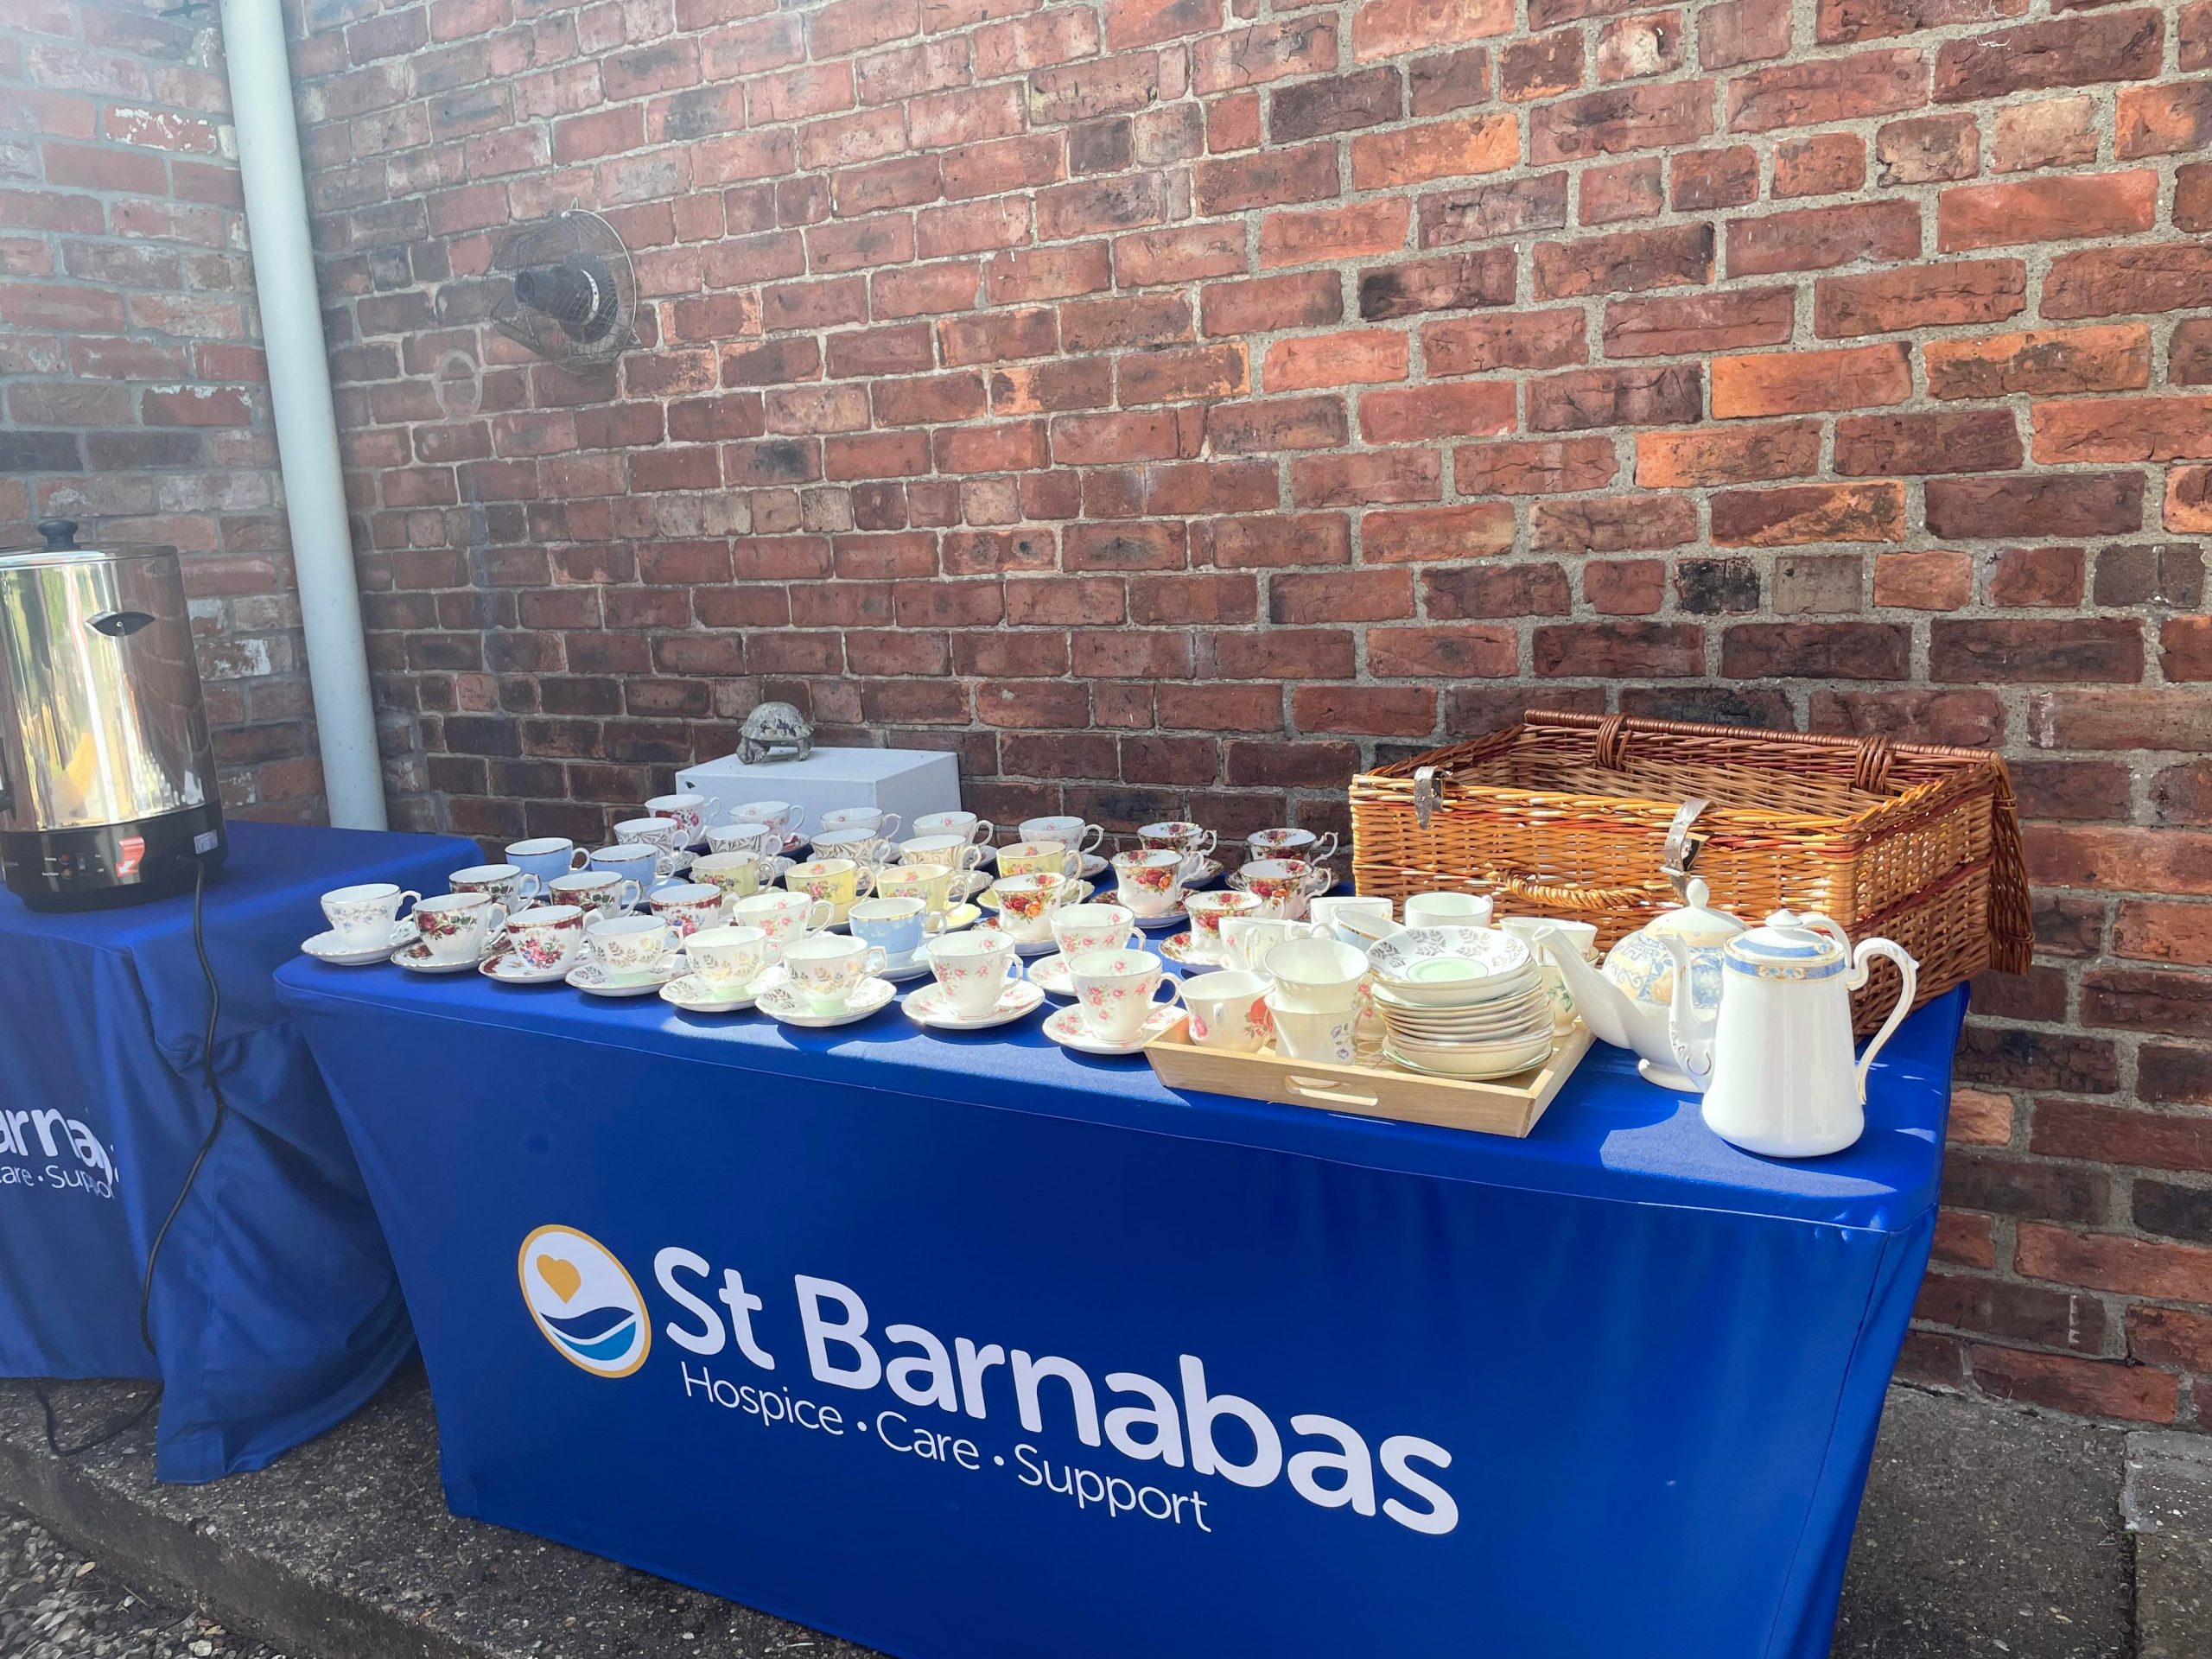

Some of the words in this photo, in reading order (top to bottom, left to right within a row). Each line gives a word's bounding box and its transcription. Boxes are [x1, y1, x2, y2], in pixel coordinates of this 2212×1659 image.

[0, 1166, 34, 1186] are
[653, 1246, 776, 1371] St
[794, 1274, 1460, 1535] Barnabas
[680, 1361, 845, 1436] Hospice
[876, 1410, 982, 1471] Care
[1014, 1443, 1212, 1534] Support
